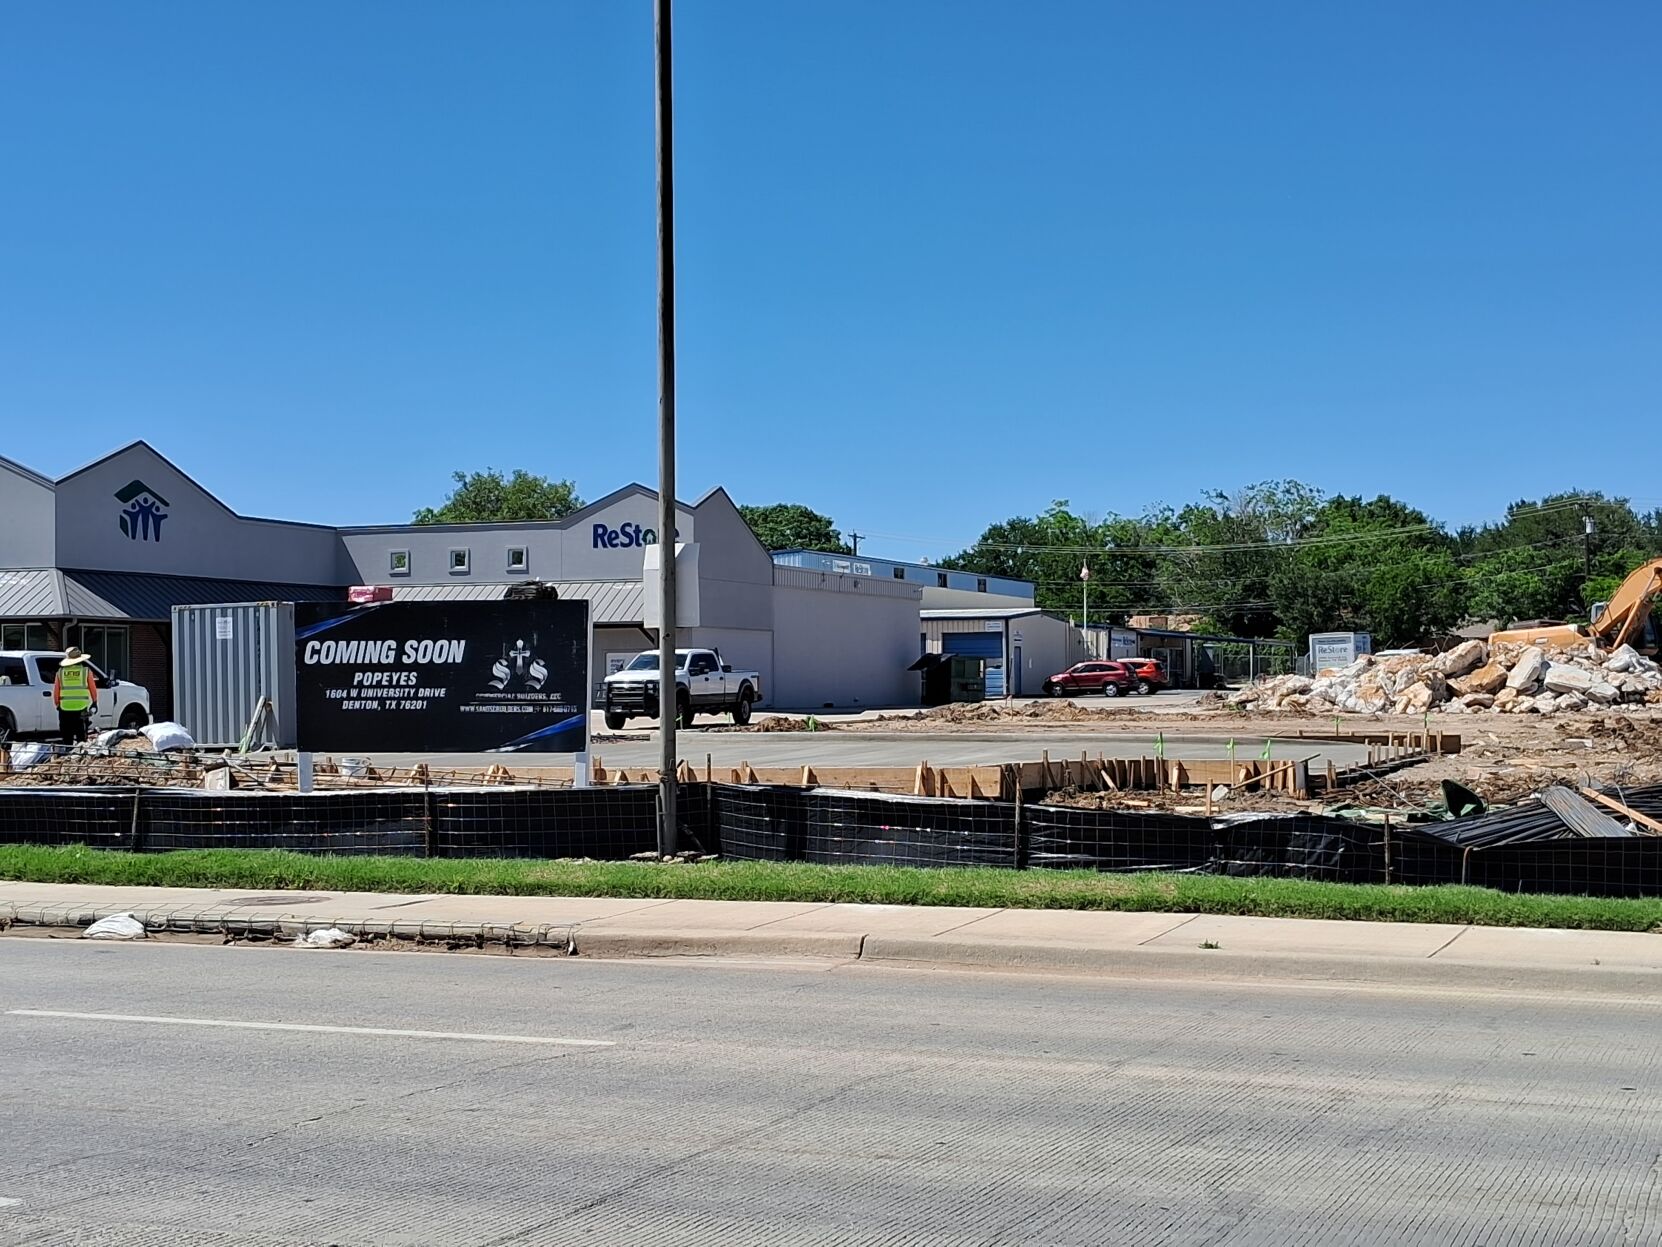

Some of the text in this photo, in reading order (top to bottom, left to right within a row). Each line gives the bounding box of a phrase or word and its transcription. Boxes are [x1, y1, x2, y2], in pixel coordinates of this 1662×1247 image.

[593, 522, 680, 549] ReSto
[304, 639, 466, 664] COMING SOON
[1318, 645, 1348, 654] ReStore
[353, 672, 418, 686] POPEYES
[325, 688, 446, 699] 1604 W UNIVERSITY DRIVE
[342, 700, 427, 711] DENTON, TX 76201
